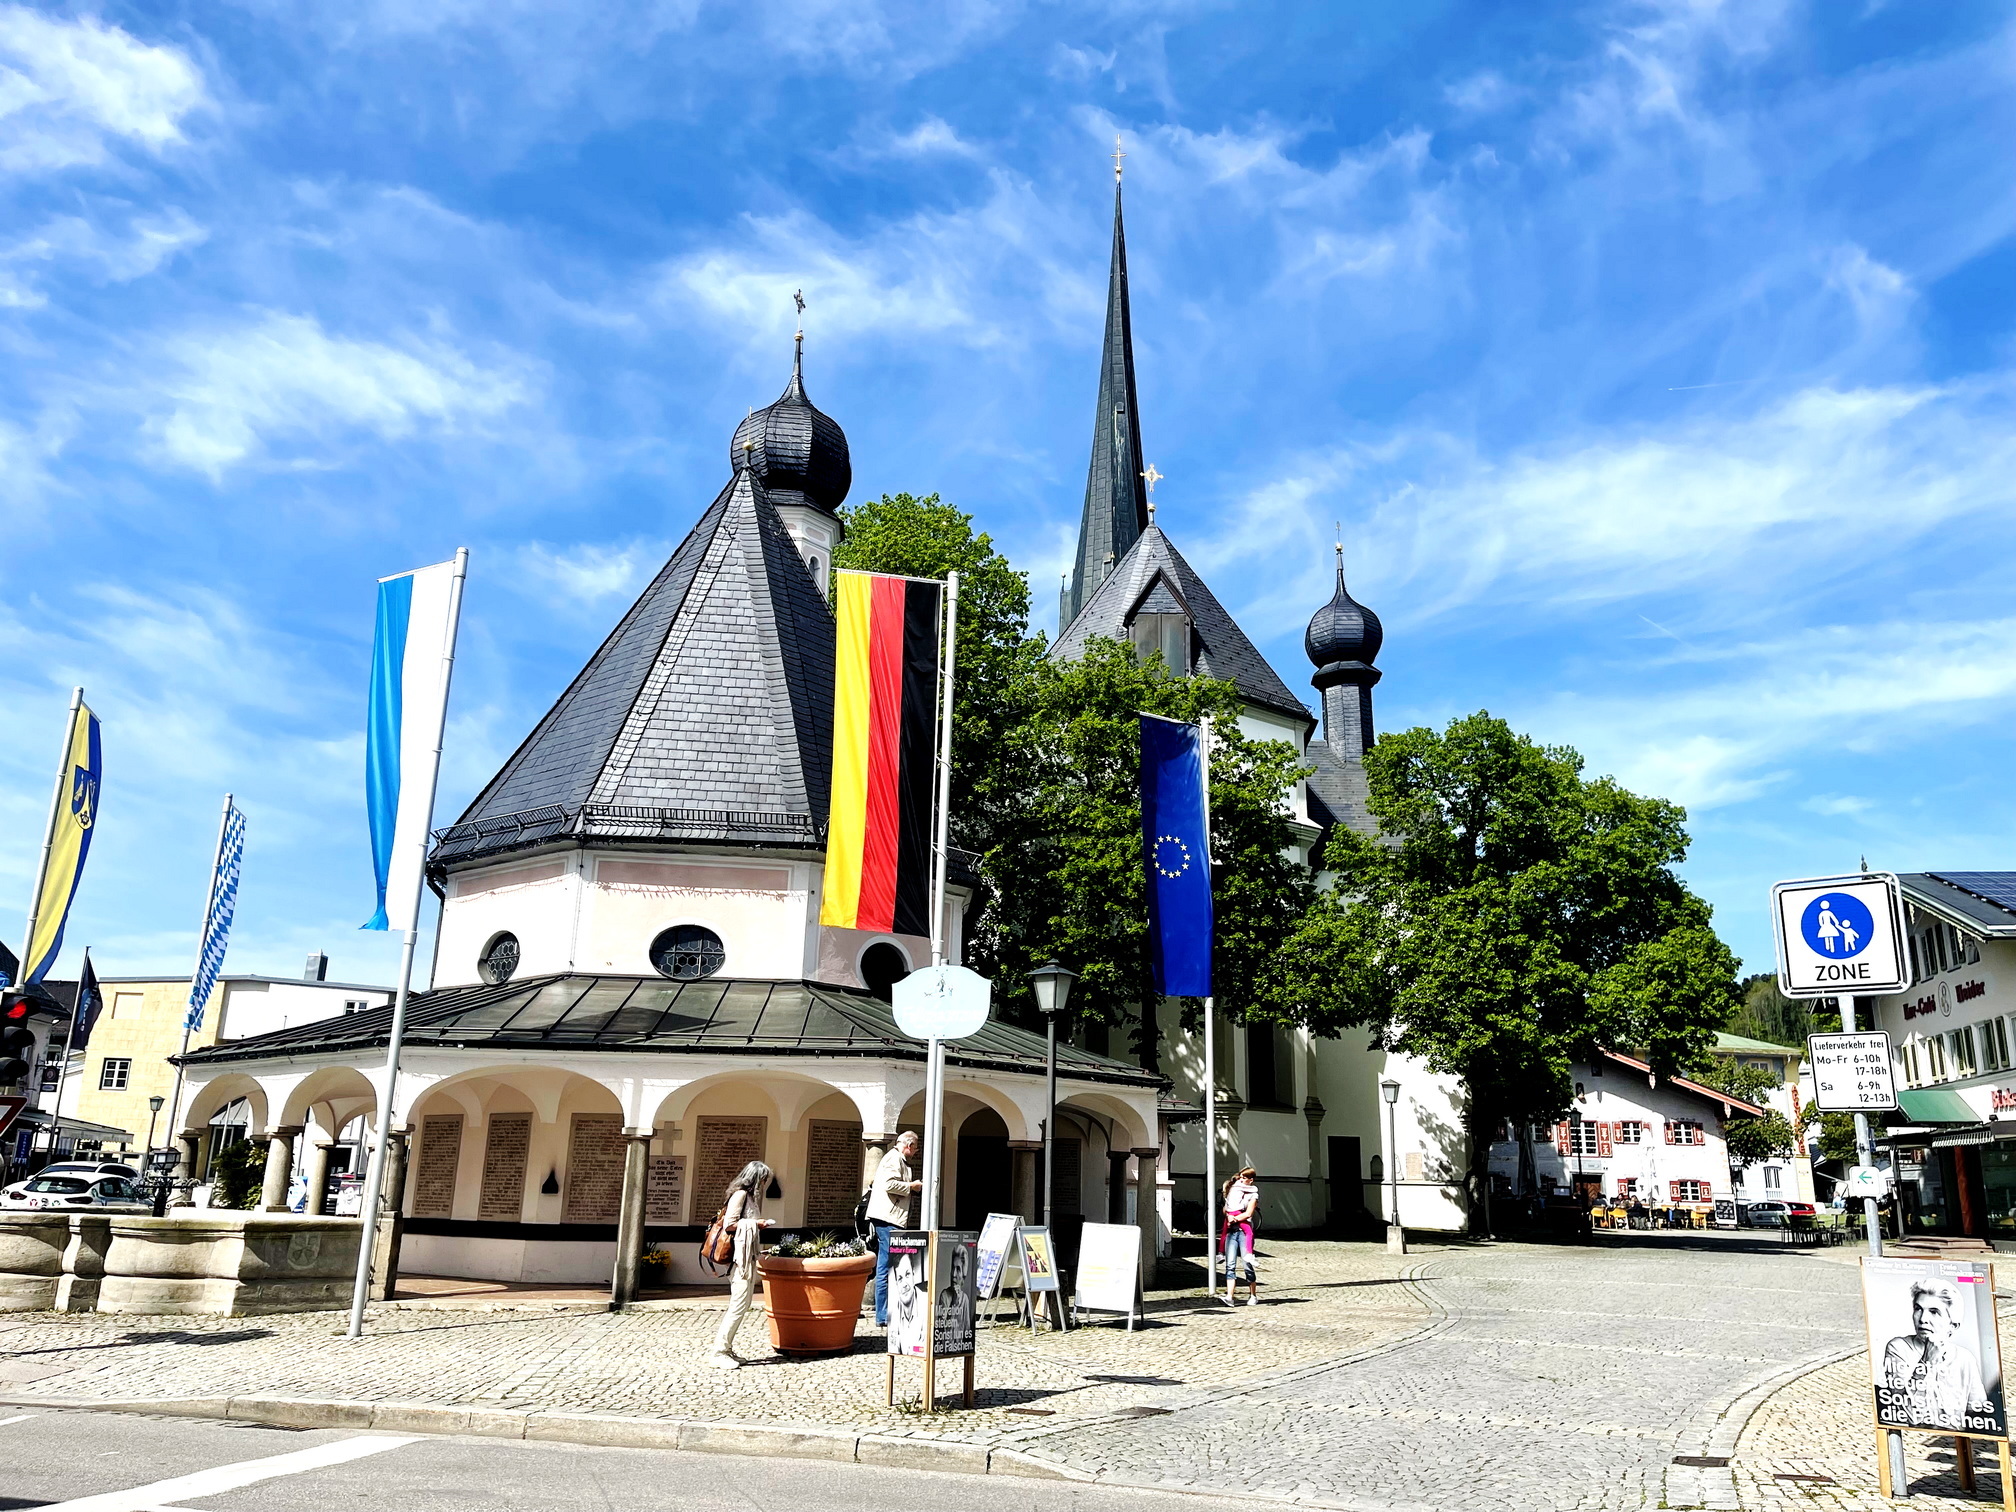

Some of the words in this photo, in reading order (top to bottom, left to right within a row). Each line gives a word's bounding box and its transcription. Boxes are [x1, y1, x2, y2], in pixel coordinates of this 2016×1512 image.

[1815, 963, 1871, 981] ZONE
[1814, 1040, 1866, 1050] Lieferverkehr
[1870, 1039, 1884, 1048] frei
[1816, 1055, 1848, 1064] Mo-Fr
[1853, 1054, 1881, 1063] 6-10h
[1855, 1066, 1887, 1076] 17-18h
[1820, 1081, 1834, 1091] Sa
[1857, 1081, 1881, 1090] 6-9h
[1859, 1093, 1891, 1103] 12-13h
[889, 1236, 899, 1246] Phil
[934, 1329, 953, 1341] Sonst
[964, 1329, 973, 1339] es
[934, 1341, 944, 1353] die
[1970, 1399, 1995, 1414] es
[1880, 1405, 1908, 1422] die
